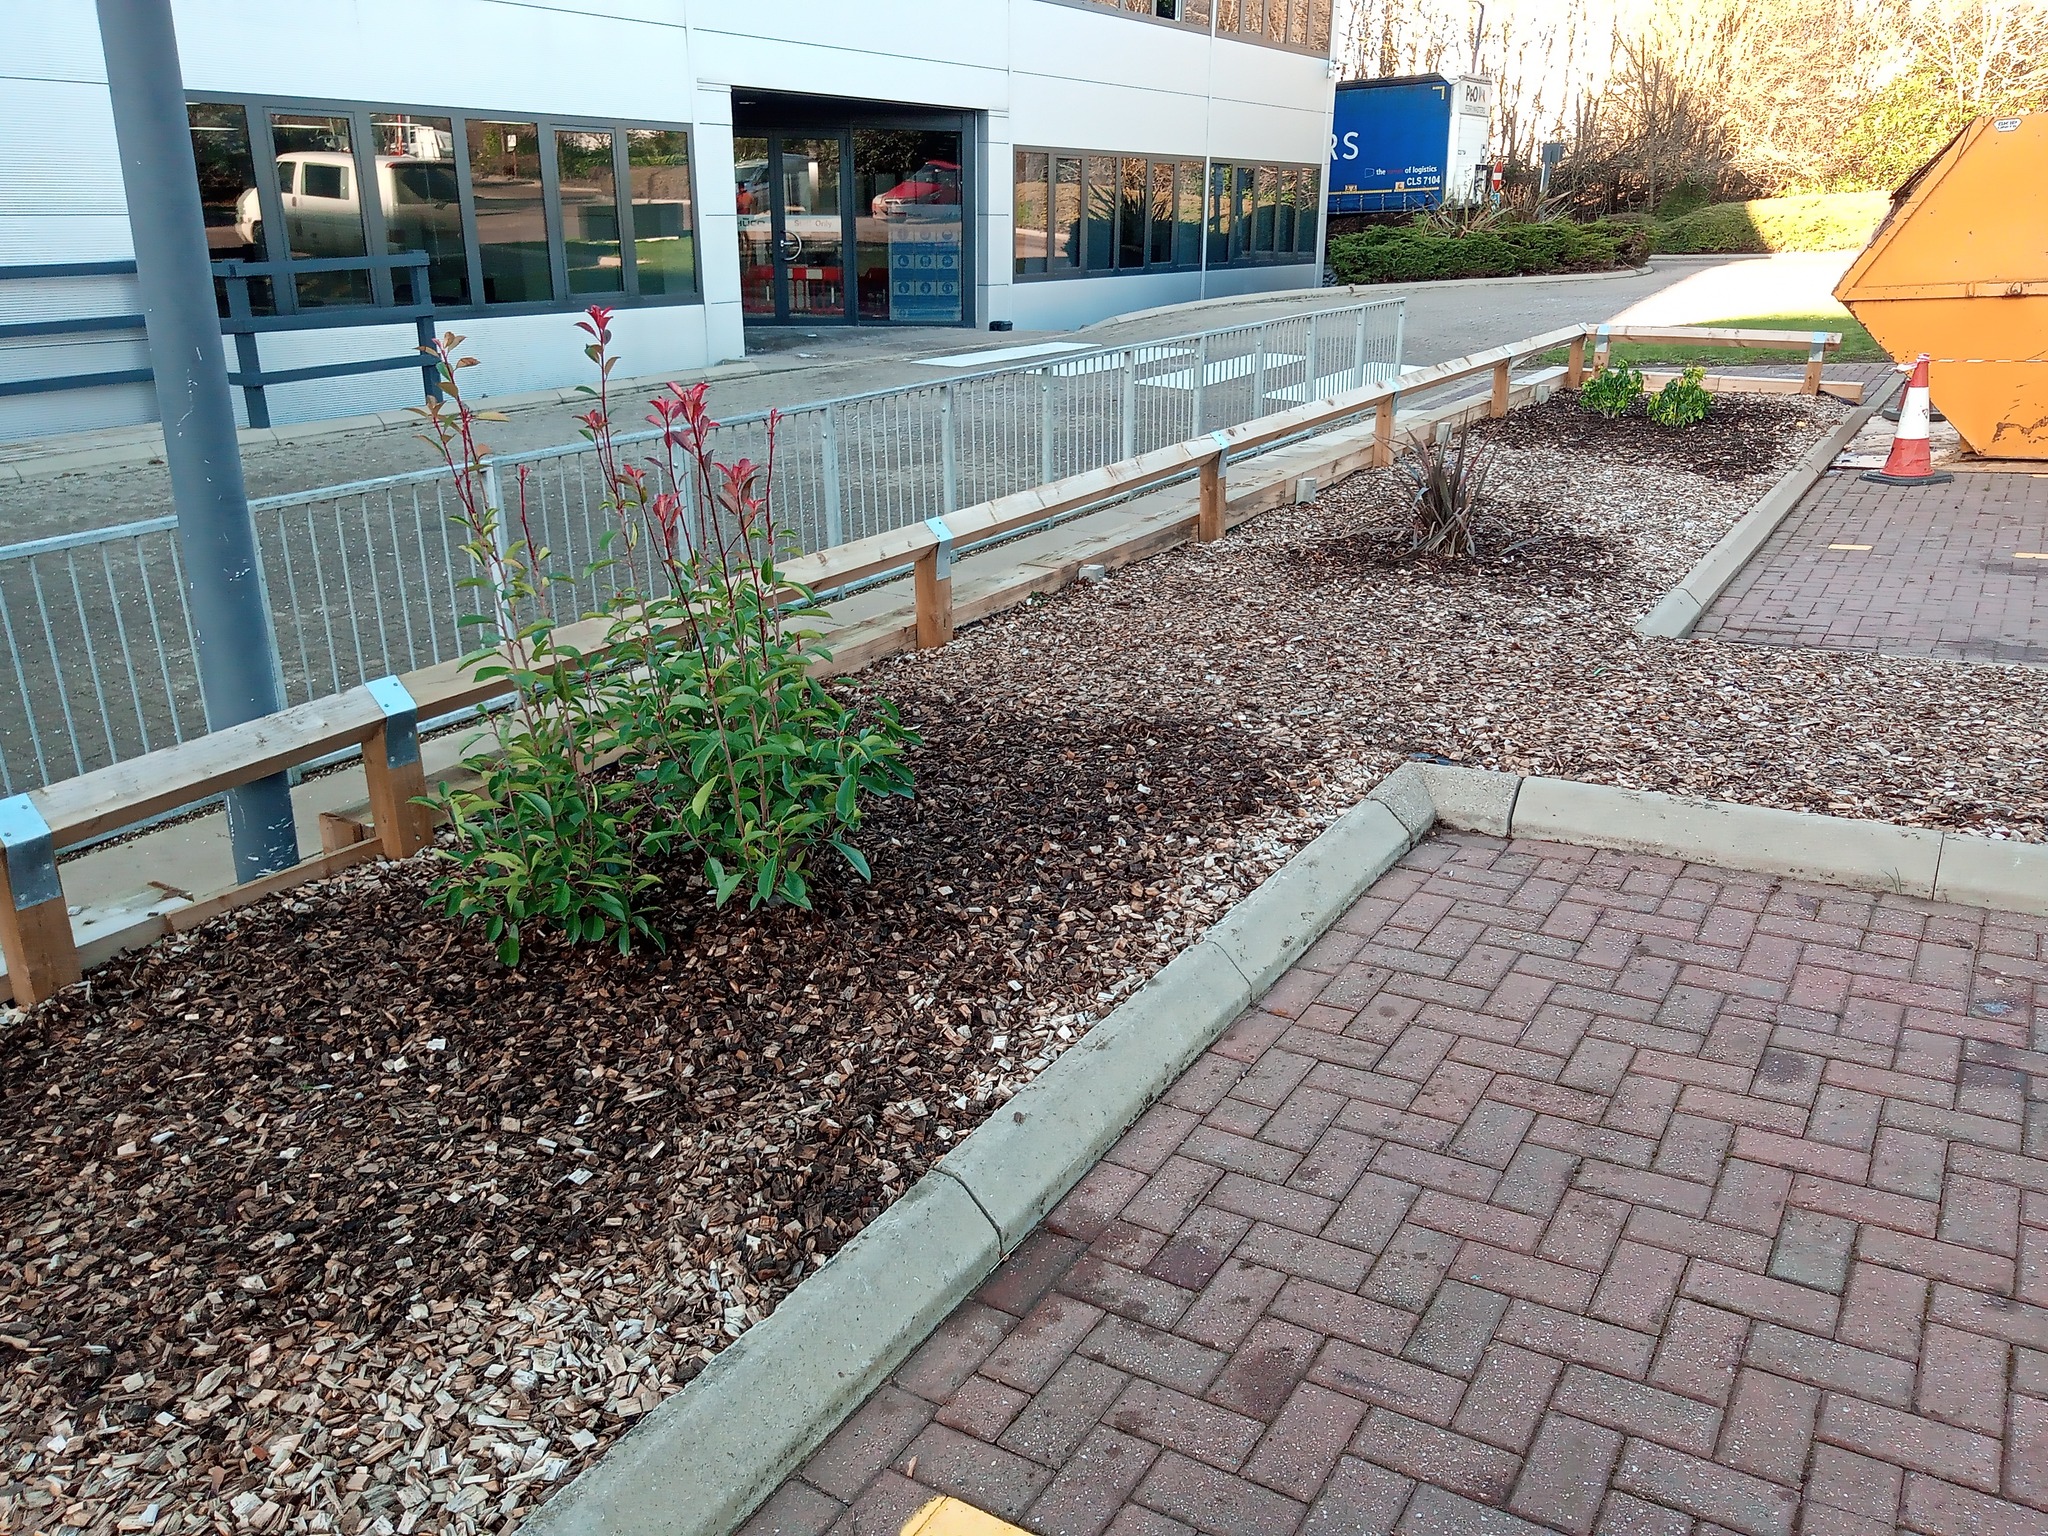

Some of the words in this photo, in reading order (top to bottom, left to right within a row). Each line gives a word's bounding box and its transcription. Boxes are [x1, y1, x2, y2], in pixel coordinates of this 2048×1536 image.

[1330, 131, 1359, 160] RS
[1404, 166, 1411, 174] of
[1412, 165, 1437, 174] logistics
[1406, 177, 1422, 186] CLS
[1423, 175, 1441, 184] 7104
